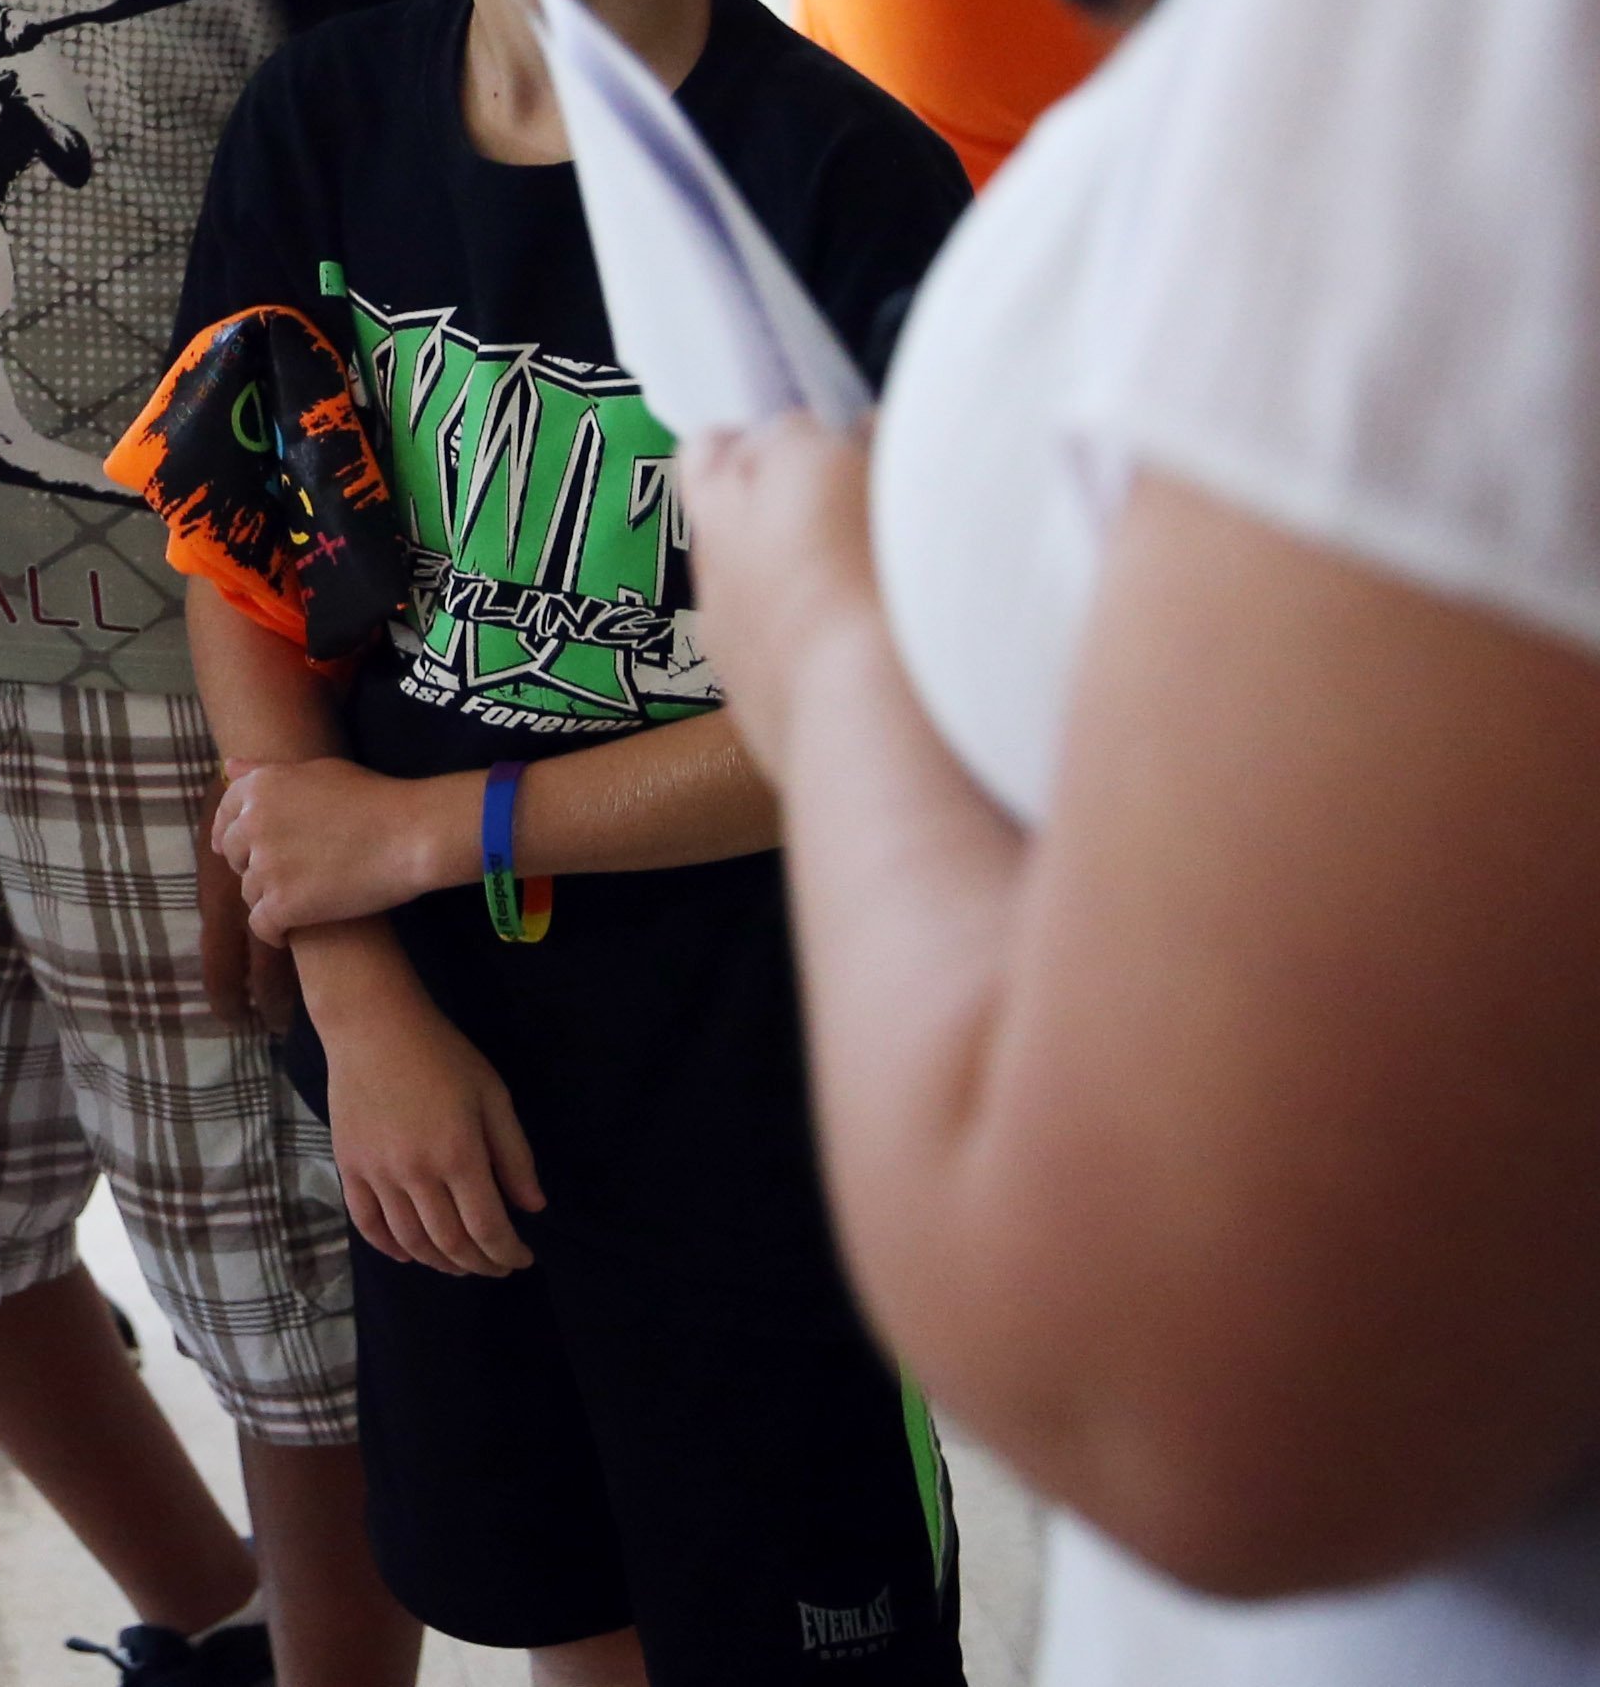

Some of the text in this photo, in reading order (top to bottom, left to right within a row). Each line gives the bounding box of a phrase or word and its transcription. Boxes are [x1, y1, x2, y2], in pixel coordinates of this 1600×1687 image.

[399, 674, 456, 707] ast
[798, 1584, 896, 1651] EVERLAST
[820, 1637, 890, 1661] SPORT
